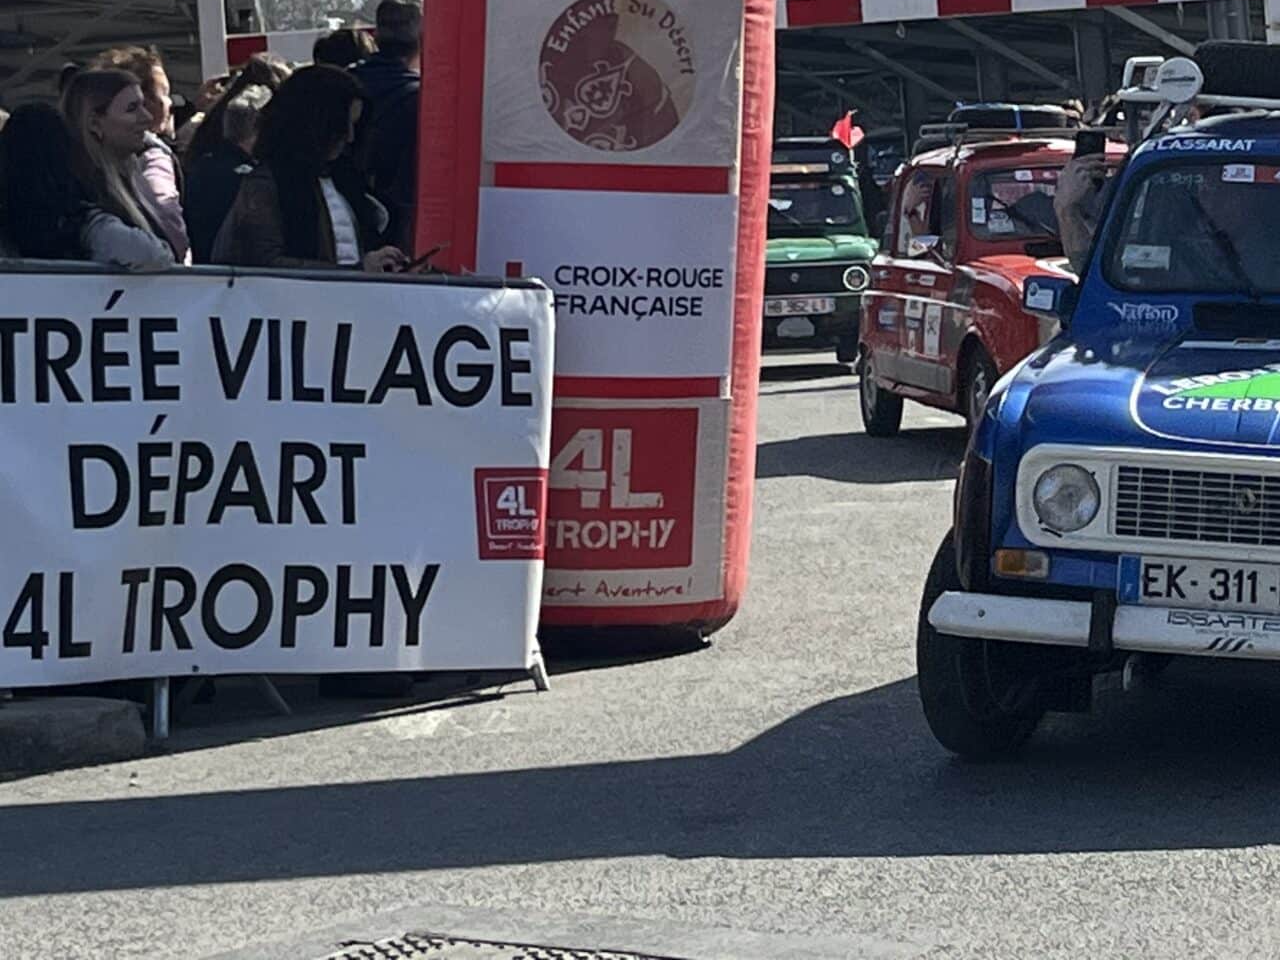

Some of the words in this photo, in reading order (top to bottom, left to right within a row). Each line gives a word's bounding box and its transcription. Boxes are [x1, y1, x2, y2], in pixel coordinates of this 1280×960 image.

[658, 10, 695, 75] Désert
[1156, 139, 1257, 151] LASSARAT
[554, 265, 724, 288] CROIX-ROUGE
[554, 294, 703, 321] FRANÇAISE
[209, 317, 534, 407] VILLAGE
[67, 413, 366, 530] DÉPART
[549, 428, 664, 509] 4L
[496, 485, 536, 516] 4L
[549, 519, 676, 549] ROPHY
[2, 571, 92, 660] 4L
[120, 563, 441, 654] TROPHY
